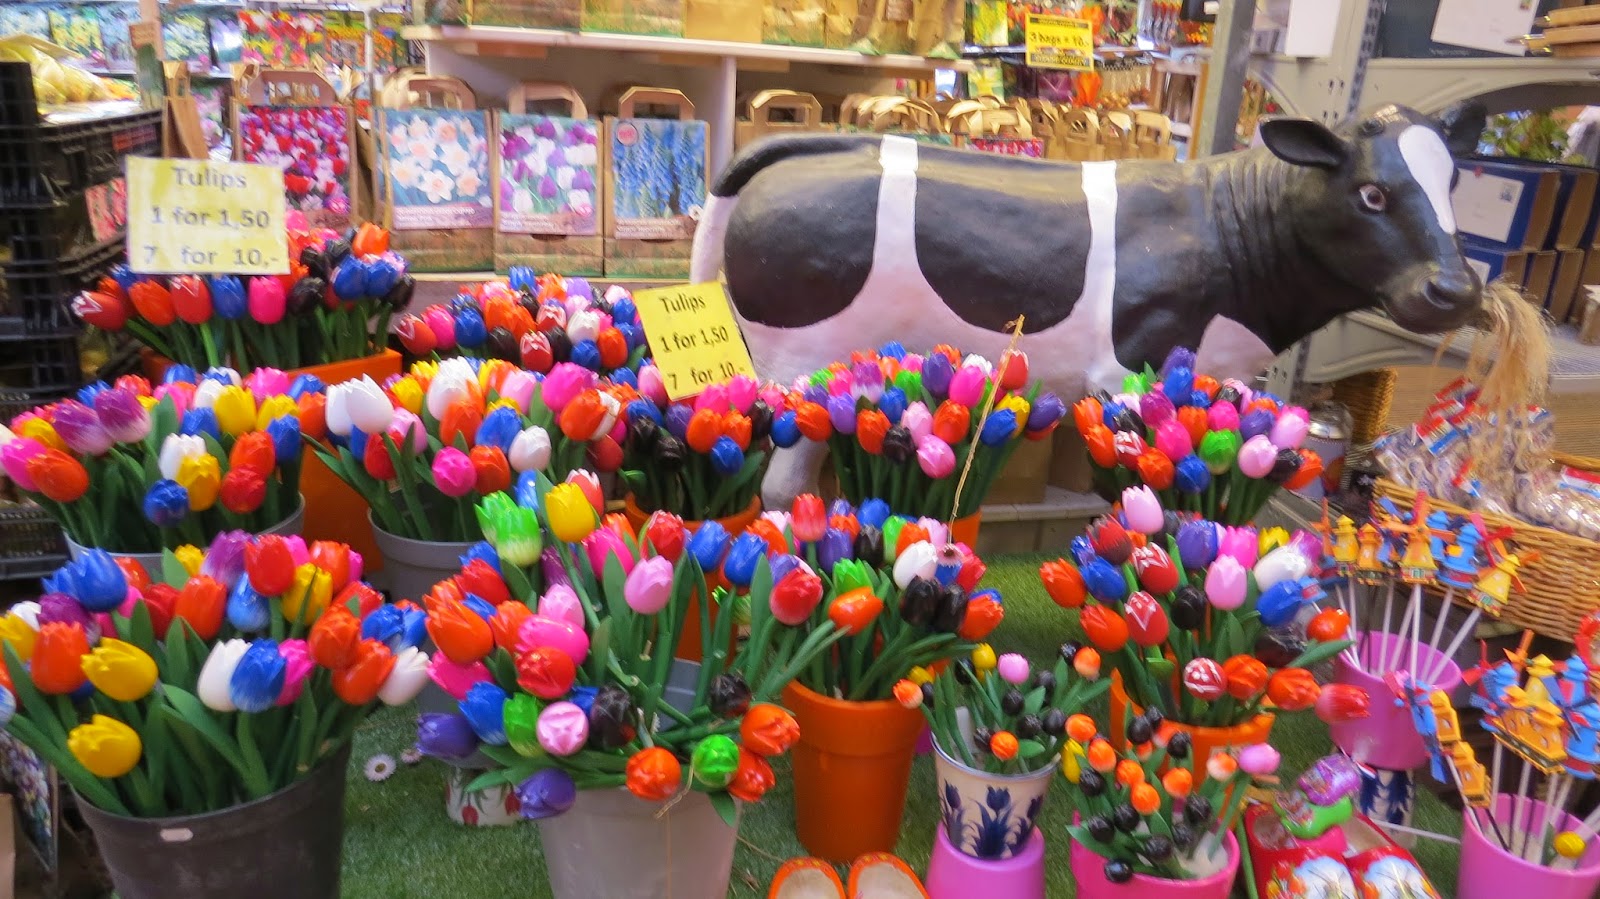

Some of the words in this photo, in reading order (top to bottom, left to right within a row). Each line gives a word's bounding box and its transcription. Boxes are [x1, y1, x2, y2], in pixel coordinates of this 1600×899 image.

[1029, 31, 1037, 42] 3
[1038, 32, 1062, 47] bags
[171, 166, 247, 192] Tulips
[151, 206, 163, 224] 1
[173, 206, 211, 226] for
[218, 208, 270, 230] 1,50
[143, 245, 158, 265] 7
[181, 245, 218, 265] for
[658, 293, 706, 314] Tulips
[660, 335, 672, 353] 1
[673, 331, 697, 351] for
[700, 326, 729, 348] 1,50
[668, 373, 678, 391] 7
[690, 366, 713, 386] for
